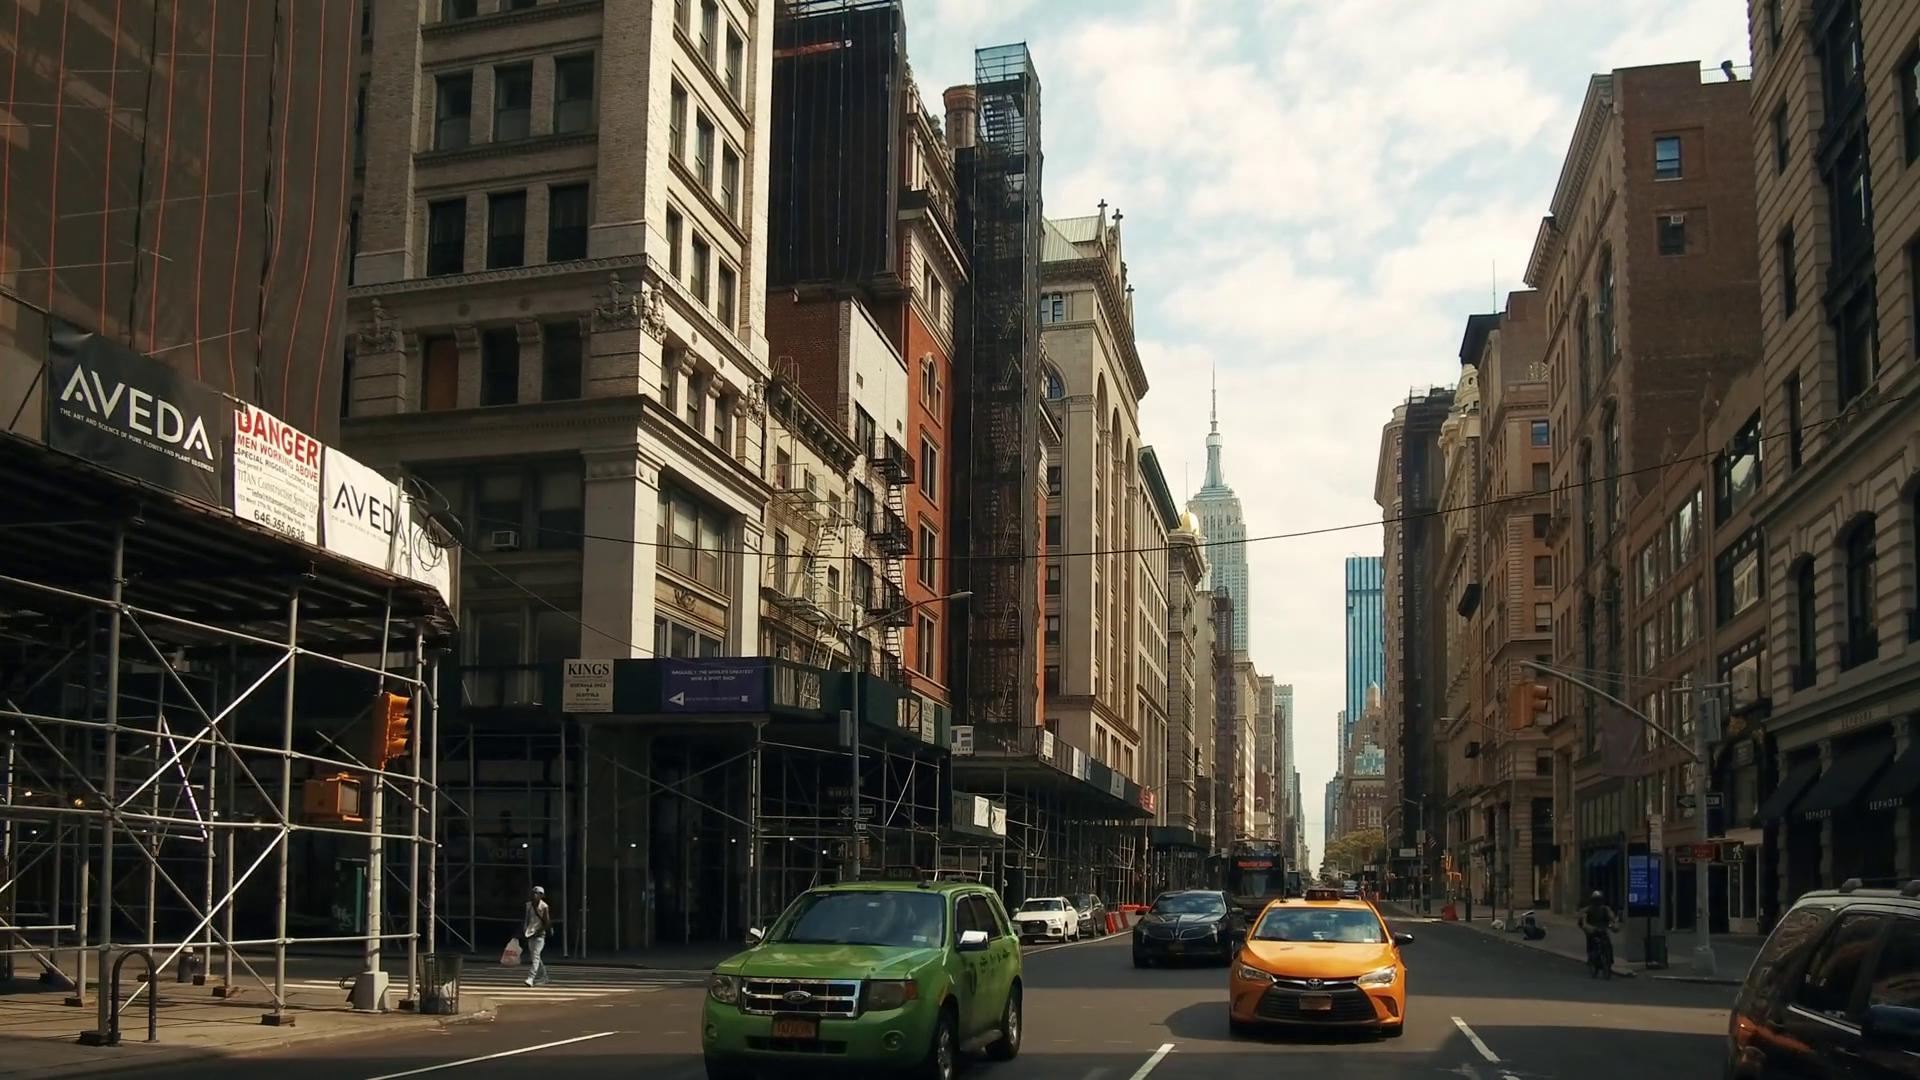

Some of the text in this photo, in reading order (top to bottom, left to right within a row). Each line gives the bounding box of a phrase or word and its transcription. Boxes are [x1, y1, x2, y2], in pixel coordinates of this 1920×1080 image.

[60, 364, 214, 461] AVEDA
[60, 407, 214, 473] THE ART AND SCIENCE OF PURE FLOWER AND PLANT ESSENCES
[237, 406, 318, 469] DANGER
[237, 448, 263, 465] SPECIAL
[237, 434, 318, 483] MEN WORKING ABOVE
[333, 482, 407, 546] AVEDA
[568, 663, 610, 676] KINGS
[1805, 809, 1831, 820] SEPHORA
[1869, 797, 1903, 811] SEPHORA
